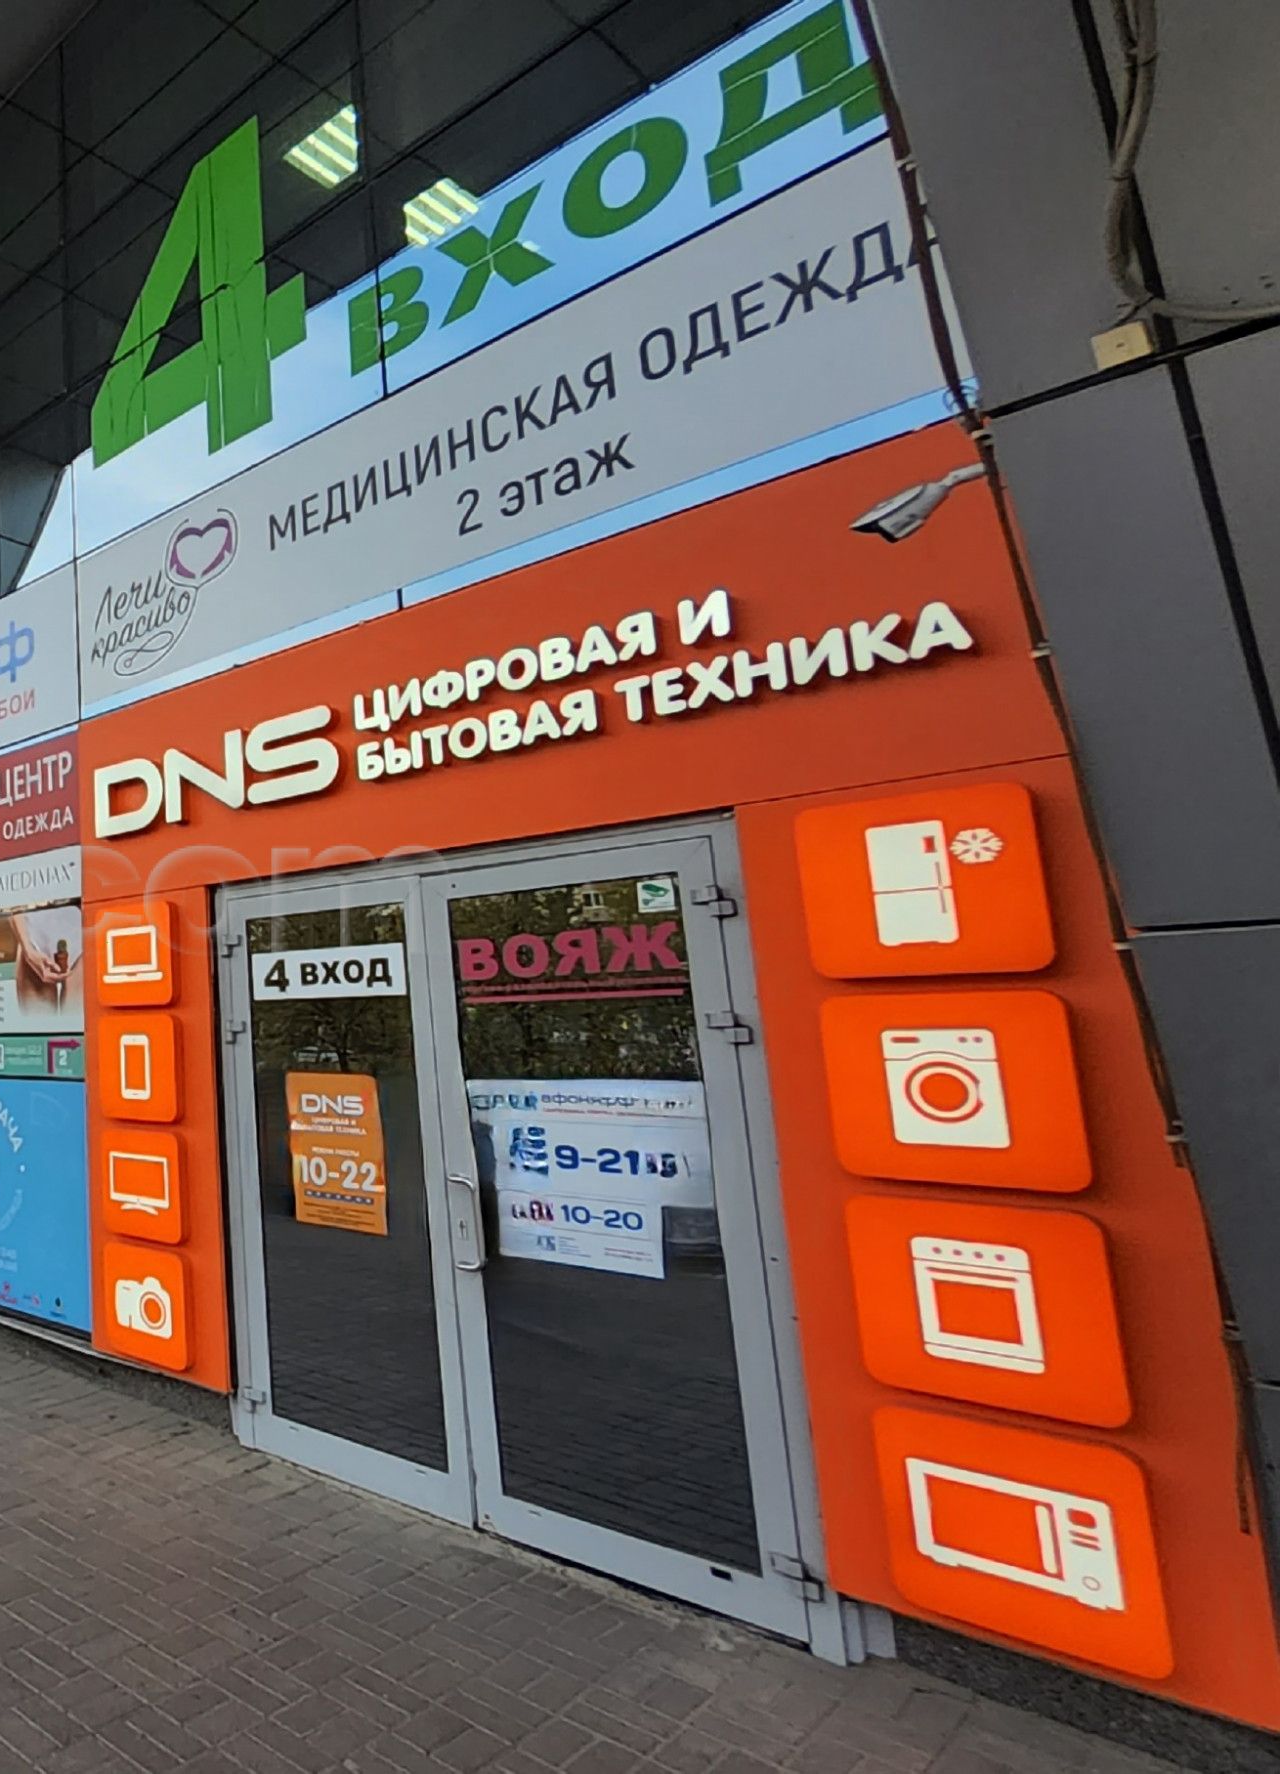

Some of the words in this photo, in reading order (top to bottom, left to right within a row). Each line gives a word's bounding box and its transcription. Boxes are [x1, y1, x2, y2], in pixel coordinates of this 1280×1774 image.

[92, 115, 306, 469] 4
[269, 352, 618, 551] МЕДИЦИНСКАЯ
[639, 221, 920, 380] ОДЕЖД
[456, 489, 484, 536] 2
[499, 434, 636, 517] этаж
[91, 587, 191, 668] красиво
[354, 608, 655, 731] ЦИФРОВАЯ
[680, 588, 731, 648] И
[356, 690, 597, 782] БЫТОВАЯ
[616, 601, 972, 724] ТЕХНИКА
[93, 704, 339, 840] DNS
[3, 806, 74, 840] ОДЕЖДА
[263, 958, 290, 992] 4
[456, 920, 684, 981] ВОЯЖ
[300, 1093, 365, 1117] DNS
[299, 1155, 383, 1193] 10-22
[560, 1203, 643, 1231] 10-20
